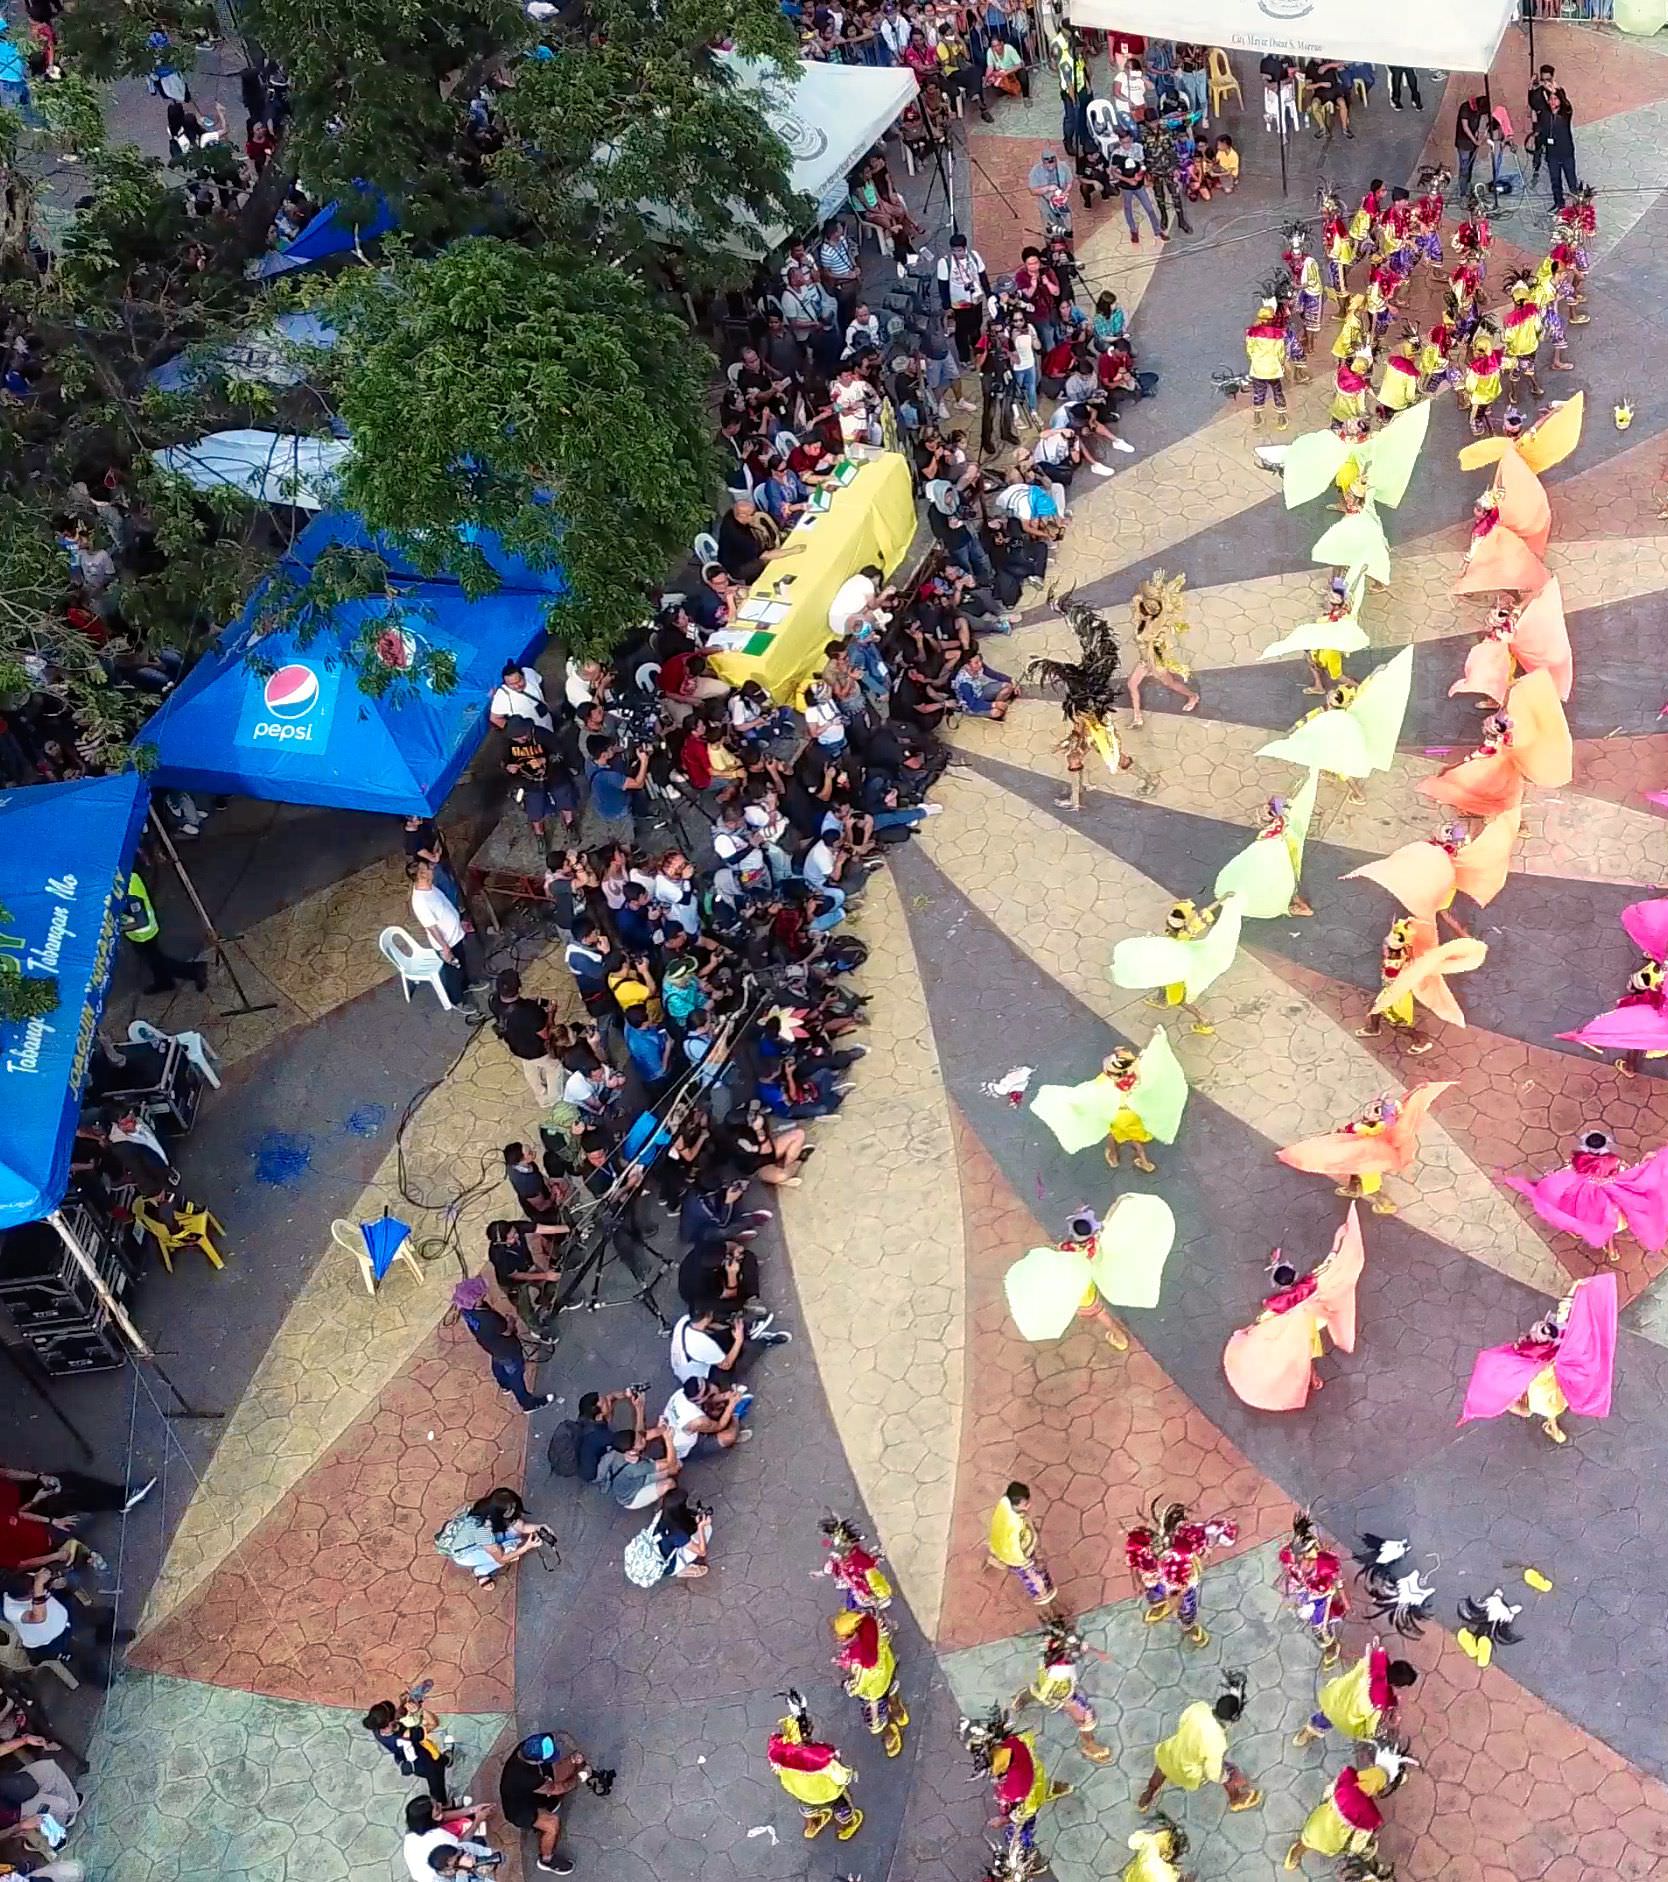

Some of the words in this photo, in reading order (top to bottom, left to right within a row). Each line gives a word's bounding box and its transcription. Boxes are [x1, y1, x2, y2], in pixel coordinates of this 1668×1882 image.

[253, 722, 313, 742] pepsi
[44, 873, 78, 901] Mo
[27, 906, 76, 974] Tabangan
